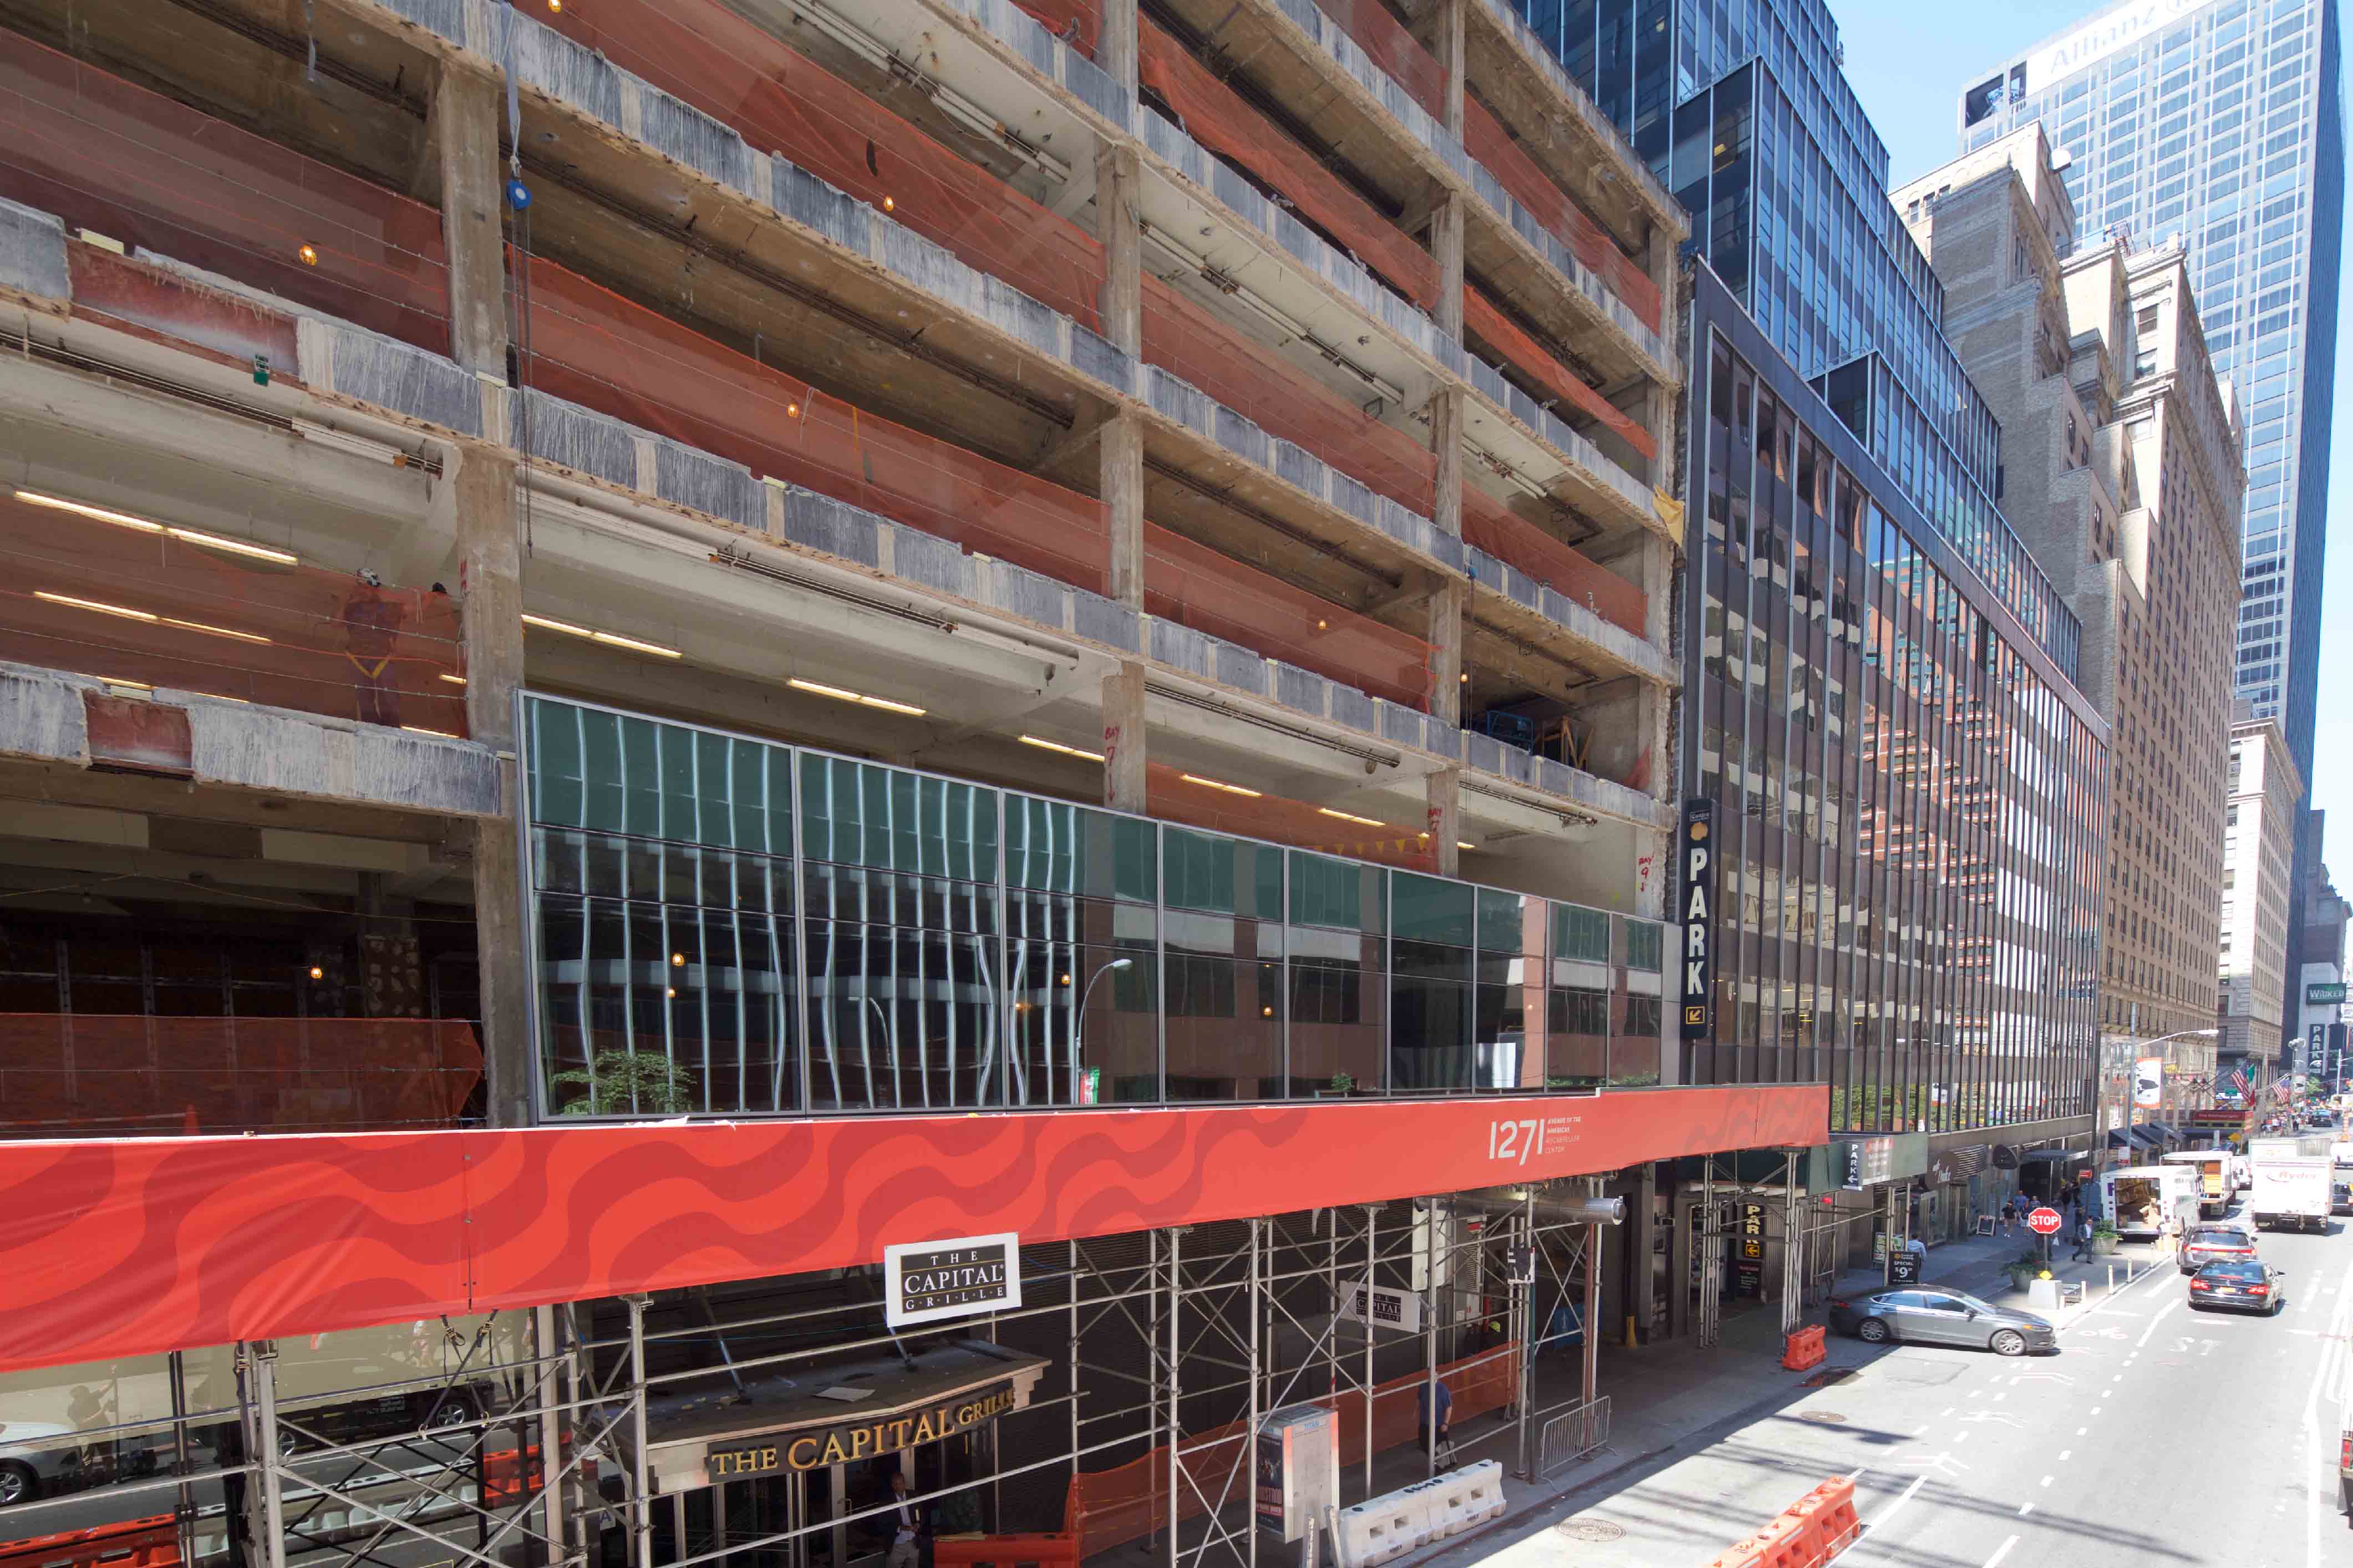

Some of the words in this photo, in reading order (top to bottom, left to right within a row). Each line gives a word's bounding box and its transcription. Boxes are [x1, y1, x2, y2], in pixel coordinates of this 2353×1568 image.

[2051, 5, 2156, 73] Allianz
[1687, 848, 1707, 995] PARK
[2311, 1026, 2321, 1059] PARK
[1489, 1118, 1544, 1166] 1271
[1850, 1144, 1858, 1174] PARK
[2030, 1215, 2059, 1225] STOP
[931, 1251, 978, 1266] THE
[904, 1264, 1003, 1294] CAPITAL
[1357, 1299, 1399, 1314] CITAL
[712, 1447, 778, 1475] THE
[787, 1408, 955, 1469] CAPITAL
